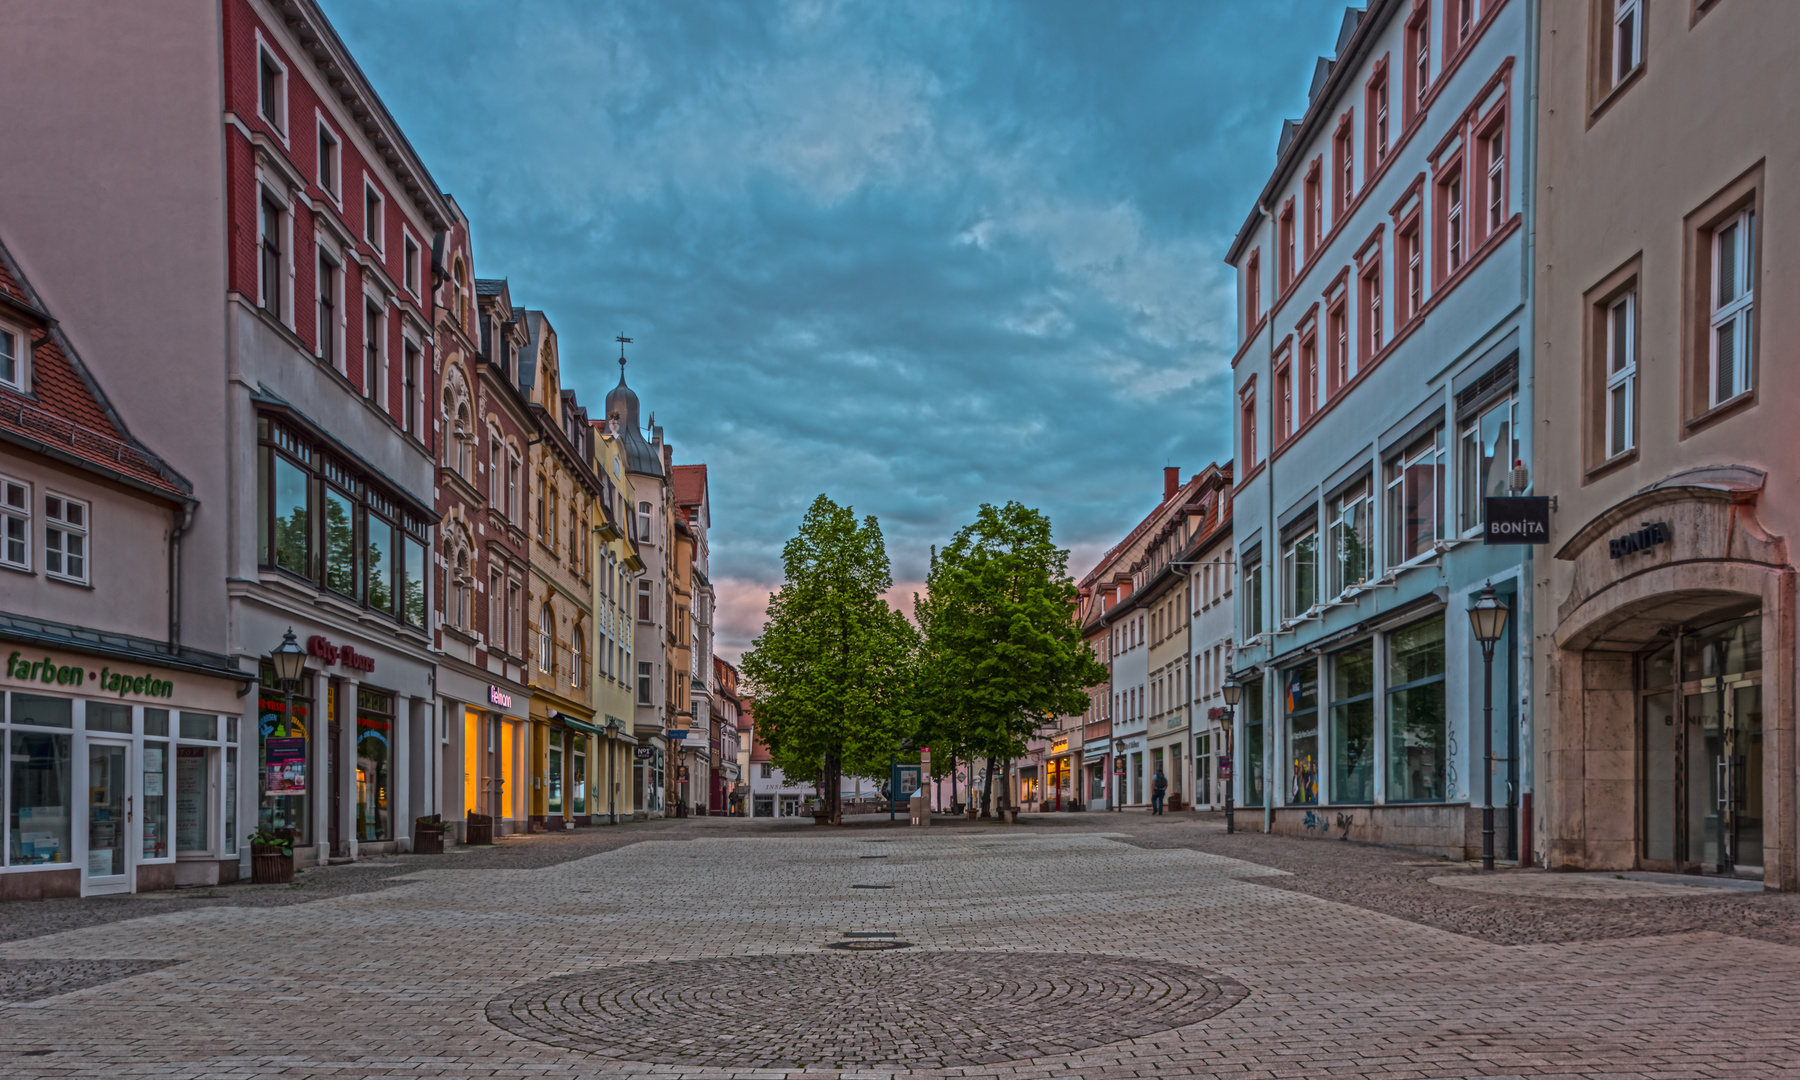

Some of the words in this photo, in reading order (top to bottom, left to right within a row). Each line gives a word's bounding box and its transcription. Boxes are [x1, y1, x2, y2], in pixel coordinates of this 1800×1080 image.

[1491, 518, 1544, 536] BONITA
[1610, 522, 1671, 559] BONITA
[308, 635, 375, 672] City-Tours
[8, 652, 84, 686] farben
[101, 667, 174, 698] tapeten
[1665, 715, 1718, 726] BNITA
